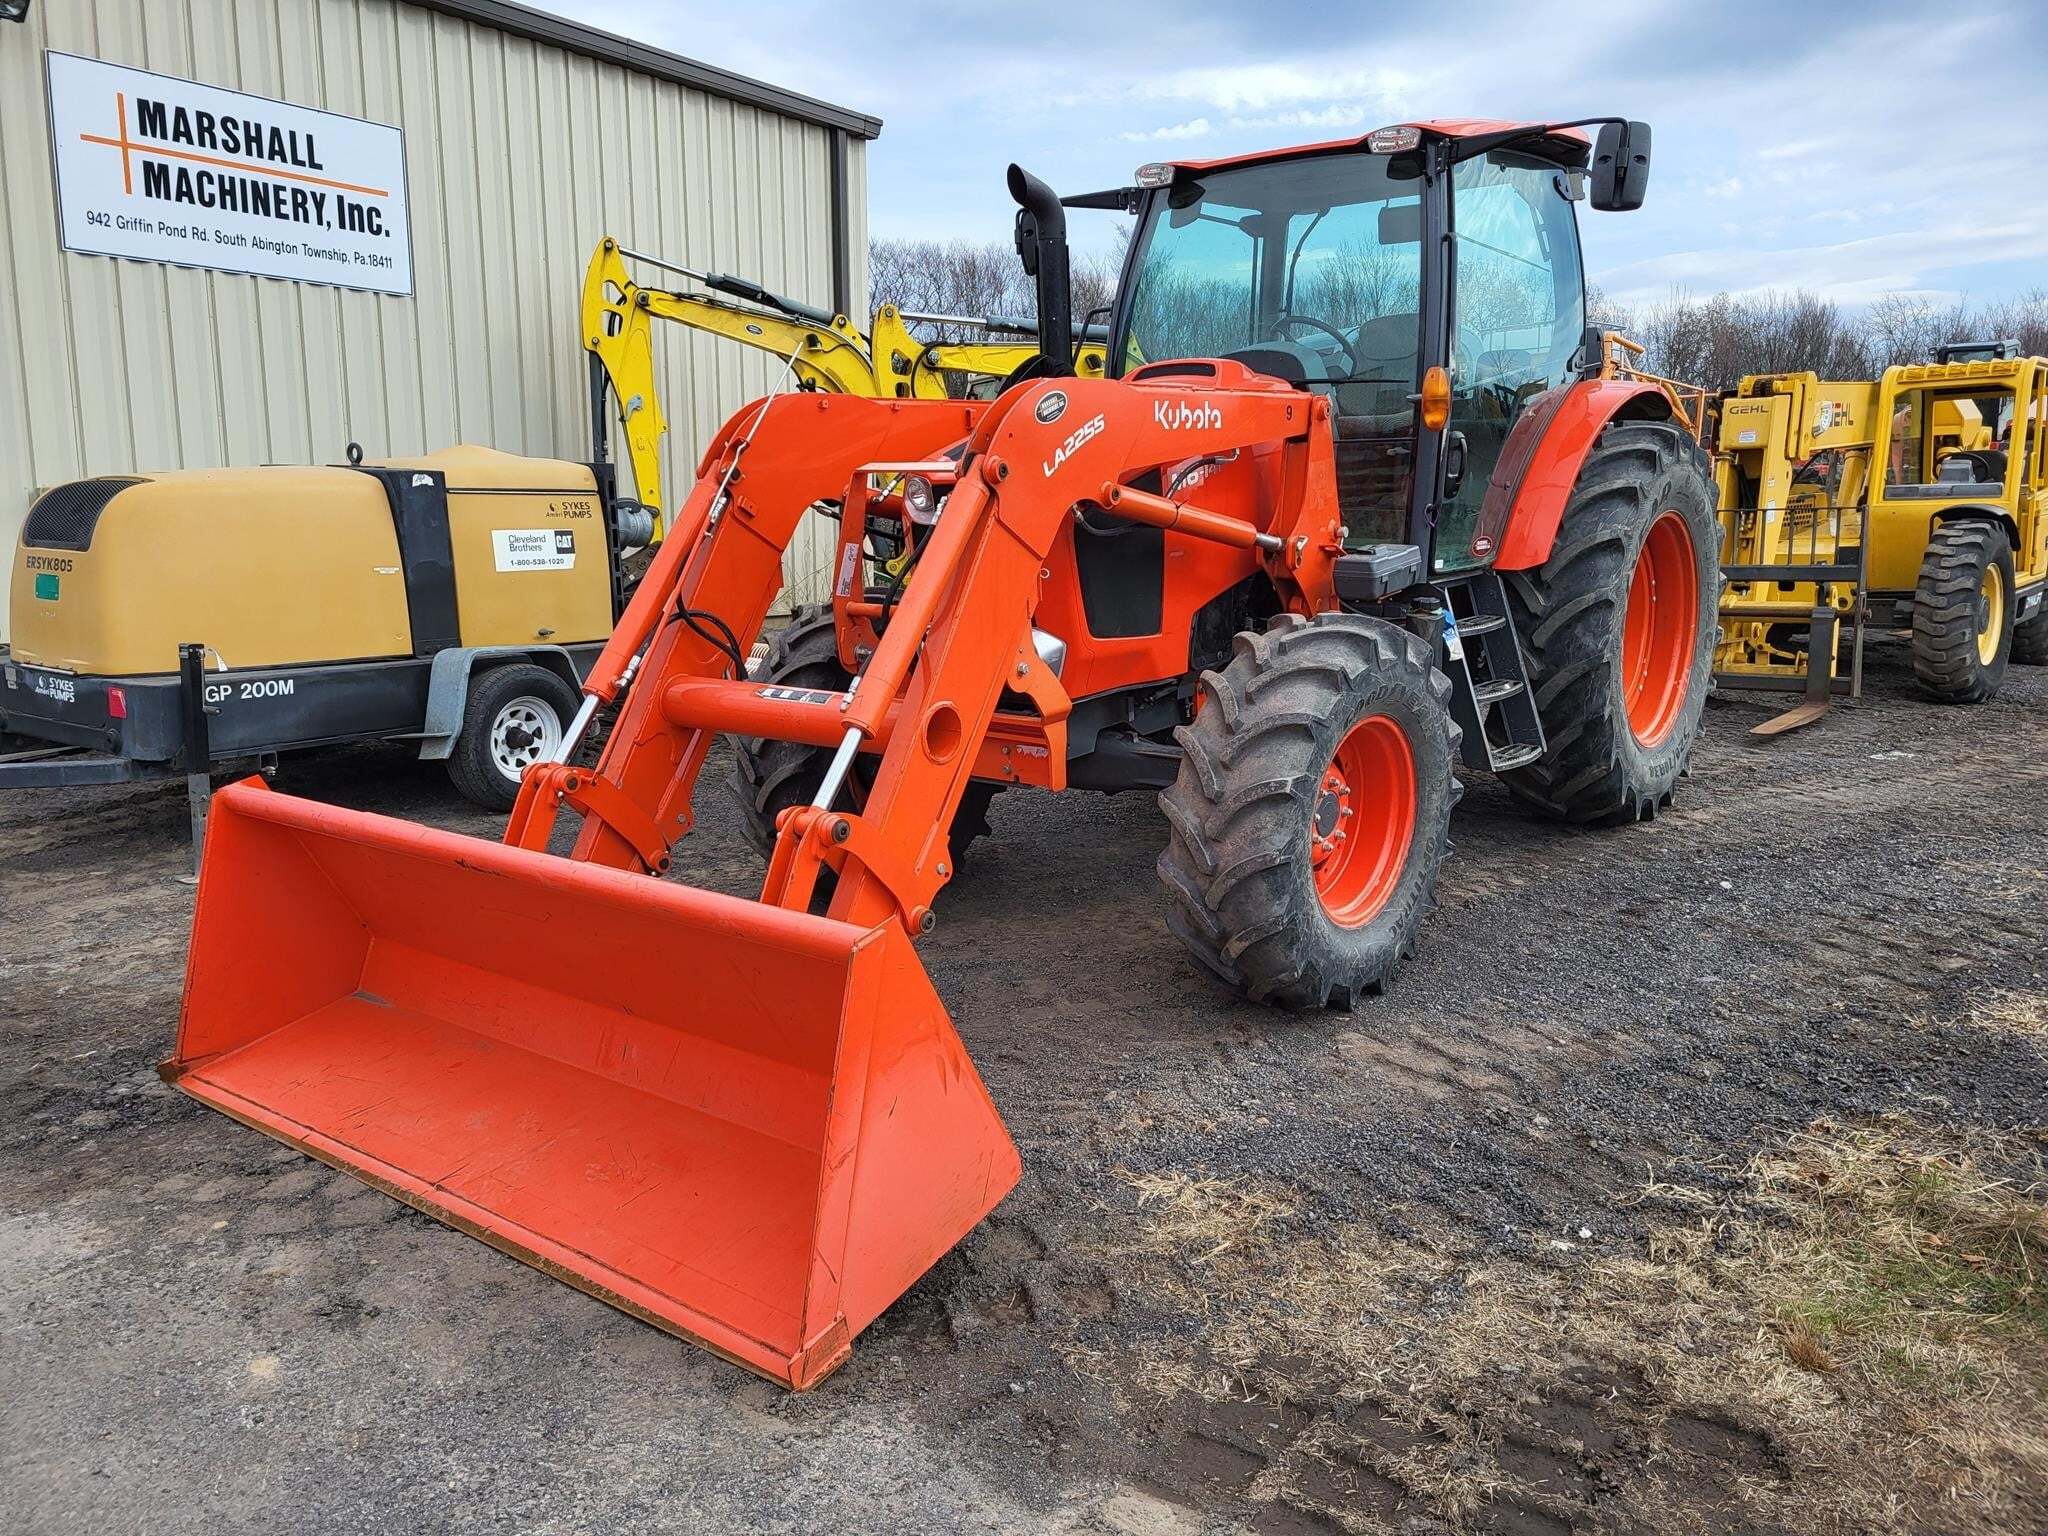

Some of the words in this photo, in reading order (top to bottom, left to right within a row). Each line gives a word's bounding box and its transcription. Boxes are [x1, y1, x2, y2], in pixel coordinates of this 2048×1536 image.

[136, 97, 324, 171] MARSHALL
[142, 160, 332, 231] MACHINERY,
[336, 194, 391, 237] Inc.
[86, 210, 111, 227] 942
[116, 215, 153, 233] Griffin
[158, 221, 187, 239] Pond
[191, 226, 210, 242] Rd.
[214, 229, 246, 247] South
[251, 235, 298, 255] Abington
[301, 243, 350, 264] Township,
[1154, 400, 1222, 430] Kubota
[1286, 405, 1293, 421] 9
[1729, 405, 1769, 415] GEHL
[1042, 412, 1105, 478] LA2255
[561, 501, 591, 510] SYKES
[563, 510, 593, 519] PUMPS
[508, 534, 547, 544] Cleveland
[556, 535, 573, 548] CAT
[509, 543, 543, 552] Brothers
[26, 555, 73, 572] ERSYK805
[48, 677, 74, 692] SYKES
[205, 684, 233, 703] GP
[240, 679, 295, 699] 200M
[49, 689, 75, 703] PUMPS
